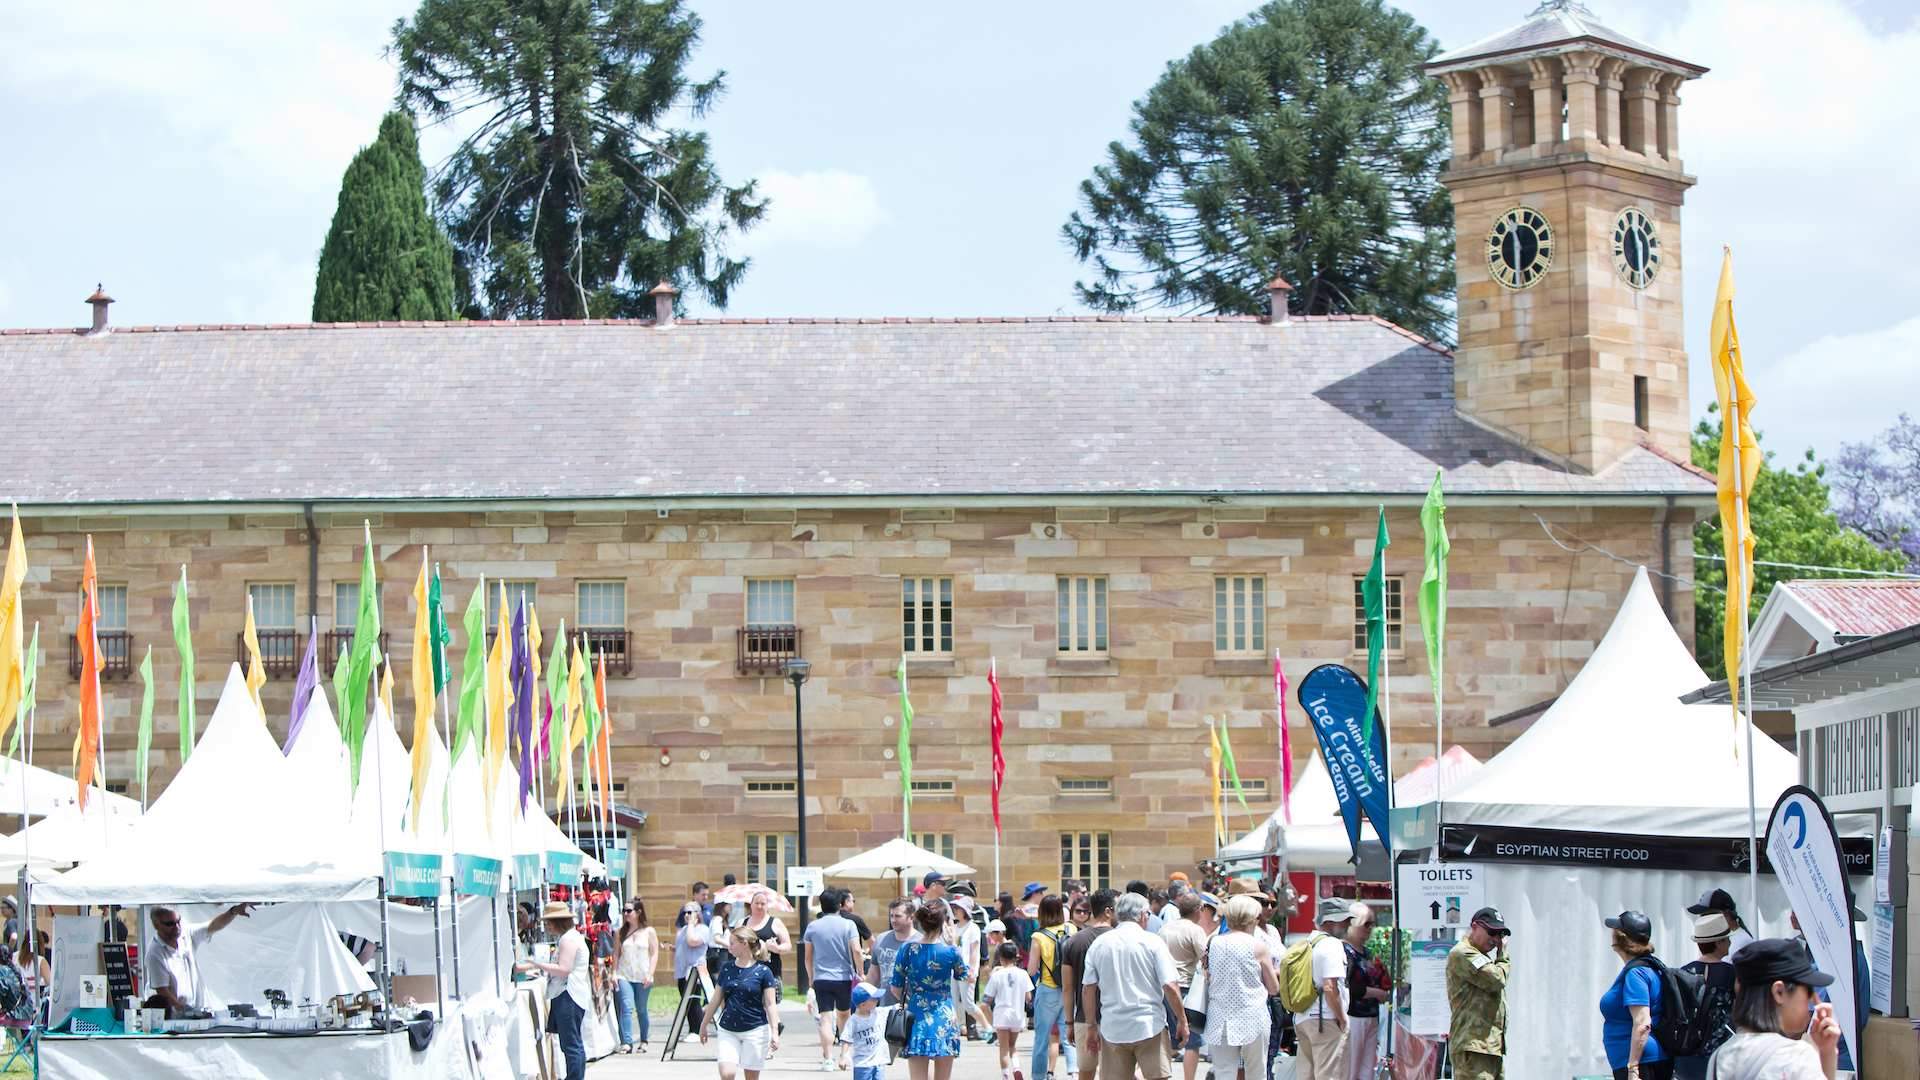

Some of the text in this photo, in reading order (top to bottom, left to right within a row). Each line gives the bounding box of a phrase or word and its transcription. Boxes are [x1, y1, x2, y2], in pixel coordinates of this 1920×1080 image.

[1344, 716, 1365, 748] Mini
[1309, 697, 1373, 798] Ice Cream
[1496, 843, 1650, 861] EGYPTIAN STREET FOOD
[1419, 869, 1473, 881] TOILETS
